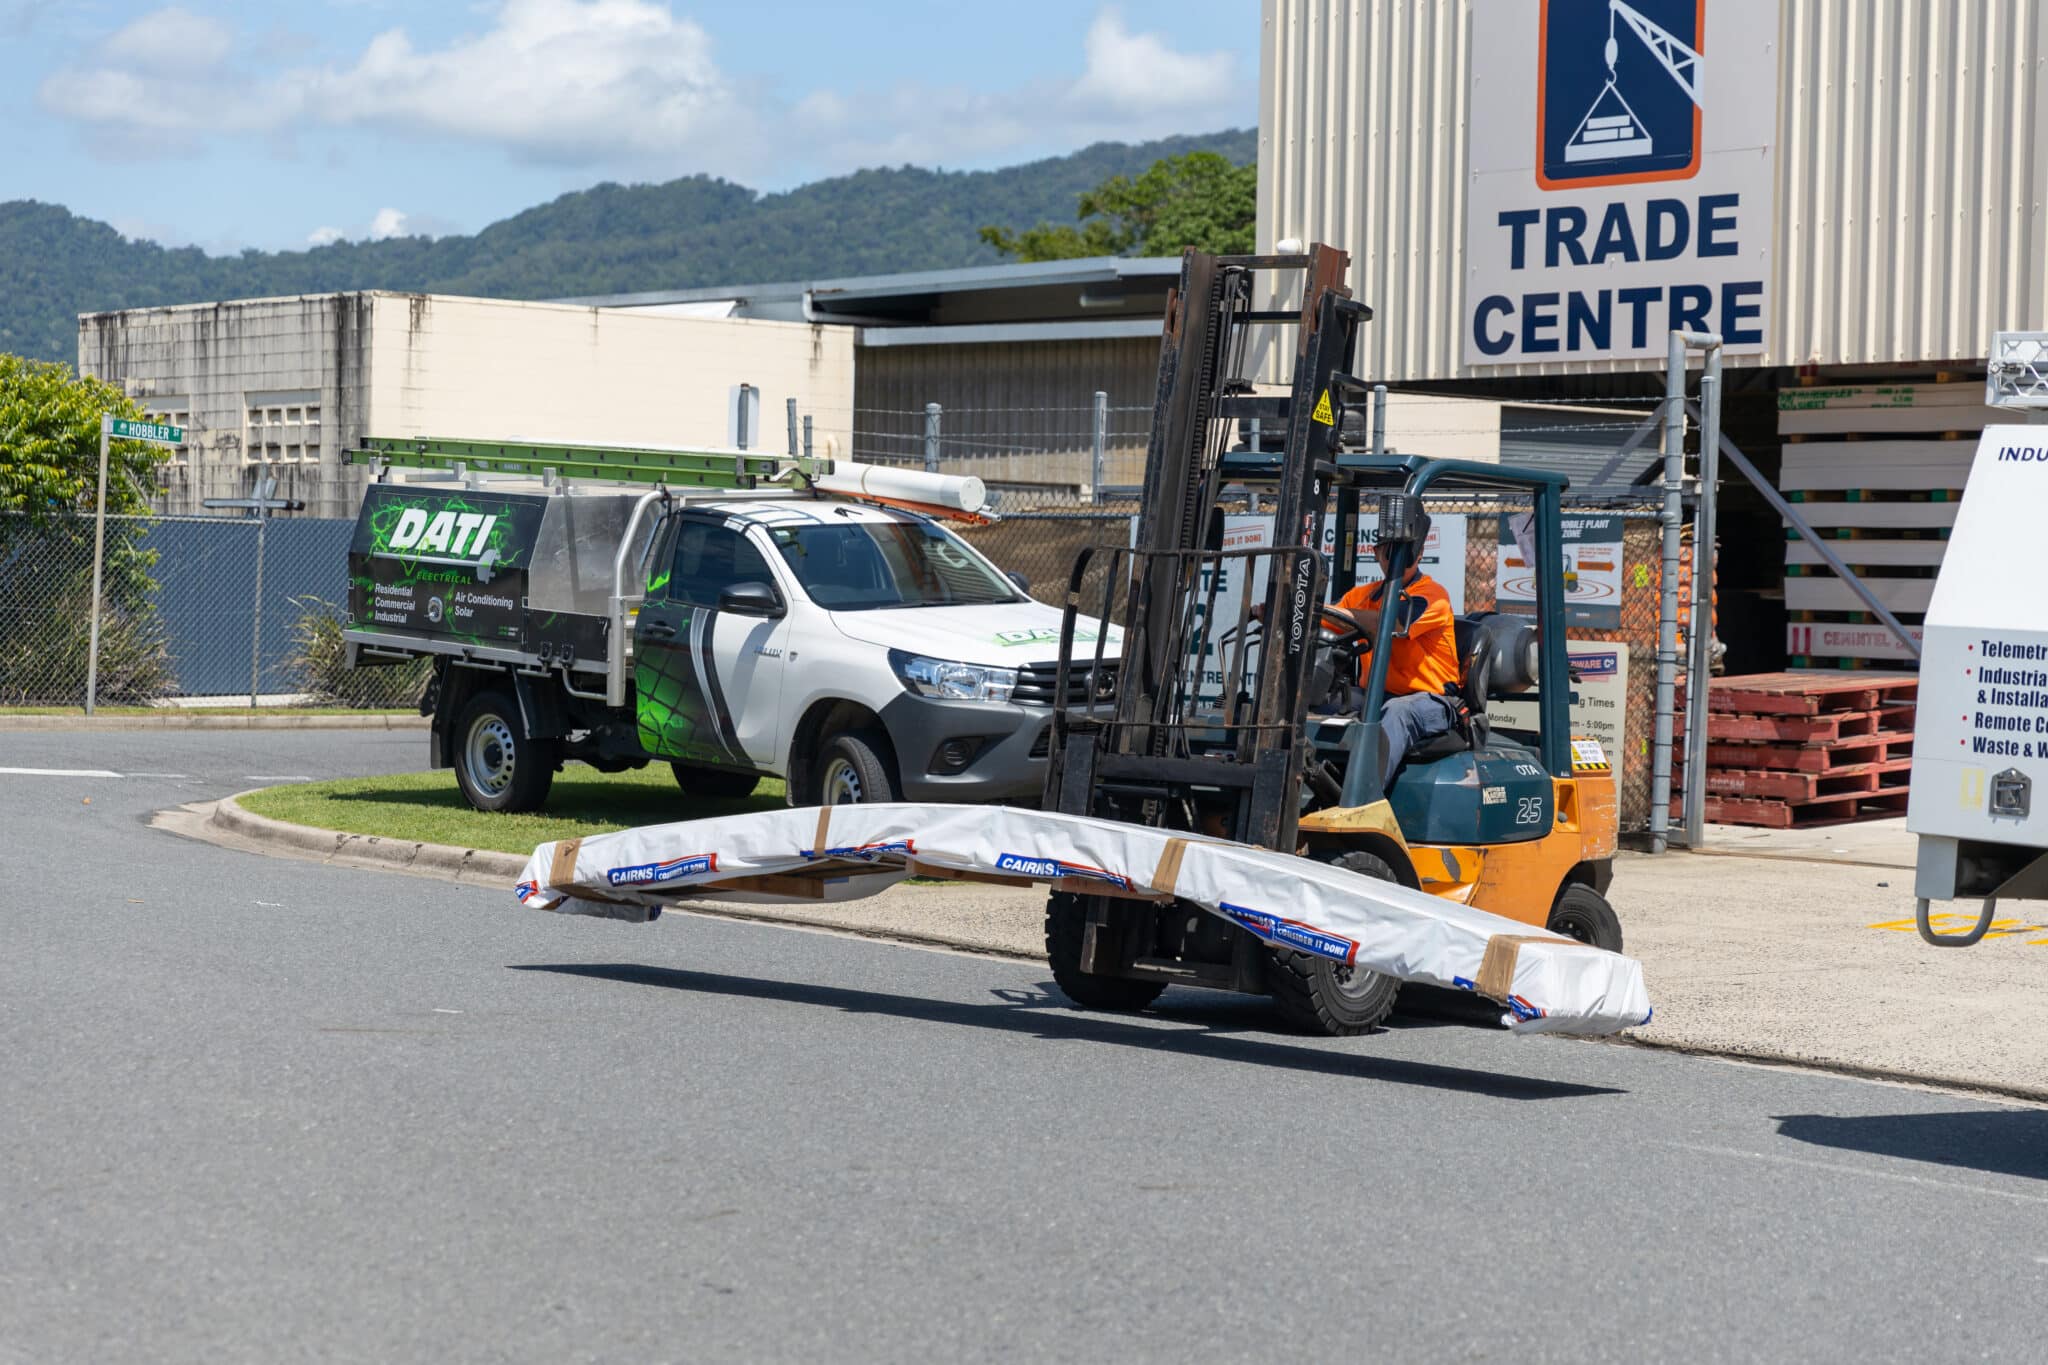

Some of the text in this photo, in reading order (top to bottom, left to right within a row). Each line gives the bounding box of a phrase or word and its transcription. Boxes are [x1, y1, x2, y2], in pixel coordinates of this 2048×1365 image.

[1498, 193, 1739, 270] TRADE
[1473, 281, 1763, 355] CENTRE
[1316, 409, 1332, 423] SAFE
[128, 423, 180, 441] HOBBLER ST
[388, 507, 498, 556] DATI
[1586, 519, 1610, 529] PLANT
[1561, 529, 1582, 538] ZONE
[415, 570, 473, 585] ELECTRICAL
[374, 582, 413, 597] Residential
[374, 596, 416, 611] Commercial
[454, 592, 514, 610] Air Conditioning
[1288, 557, 1312, 655] TOYOTA
[374, 610, 407, 624] Industrial
[454, 605, 474, 617] Solar
[1588, 696, 1615, 708] Times
[1977, 689, 1987, 704] &
[1487, 712, 1517, 725] Monday
[1586, 720, 1614, 731] 5:00pm
[1974, 712, 2031, 732] Remote
[1972, 736, 2019, 756] Waste
[2023, 742, 2033, 758] &
[1516, 797, 1543, 824] 25
[1002, 857, 1055, 876] CAIRNS
[611, 867, 654, 884] CAIRNS
[1277, 928, 1346, 956] CONSIDER IT DONE
